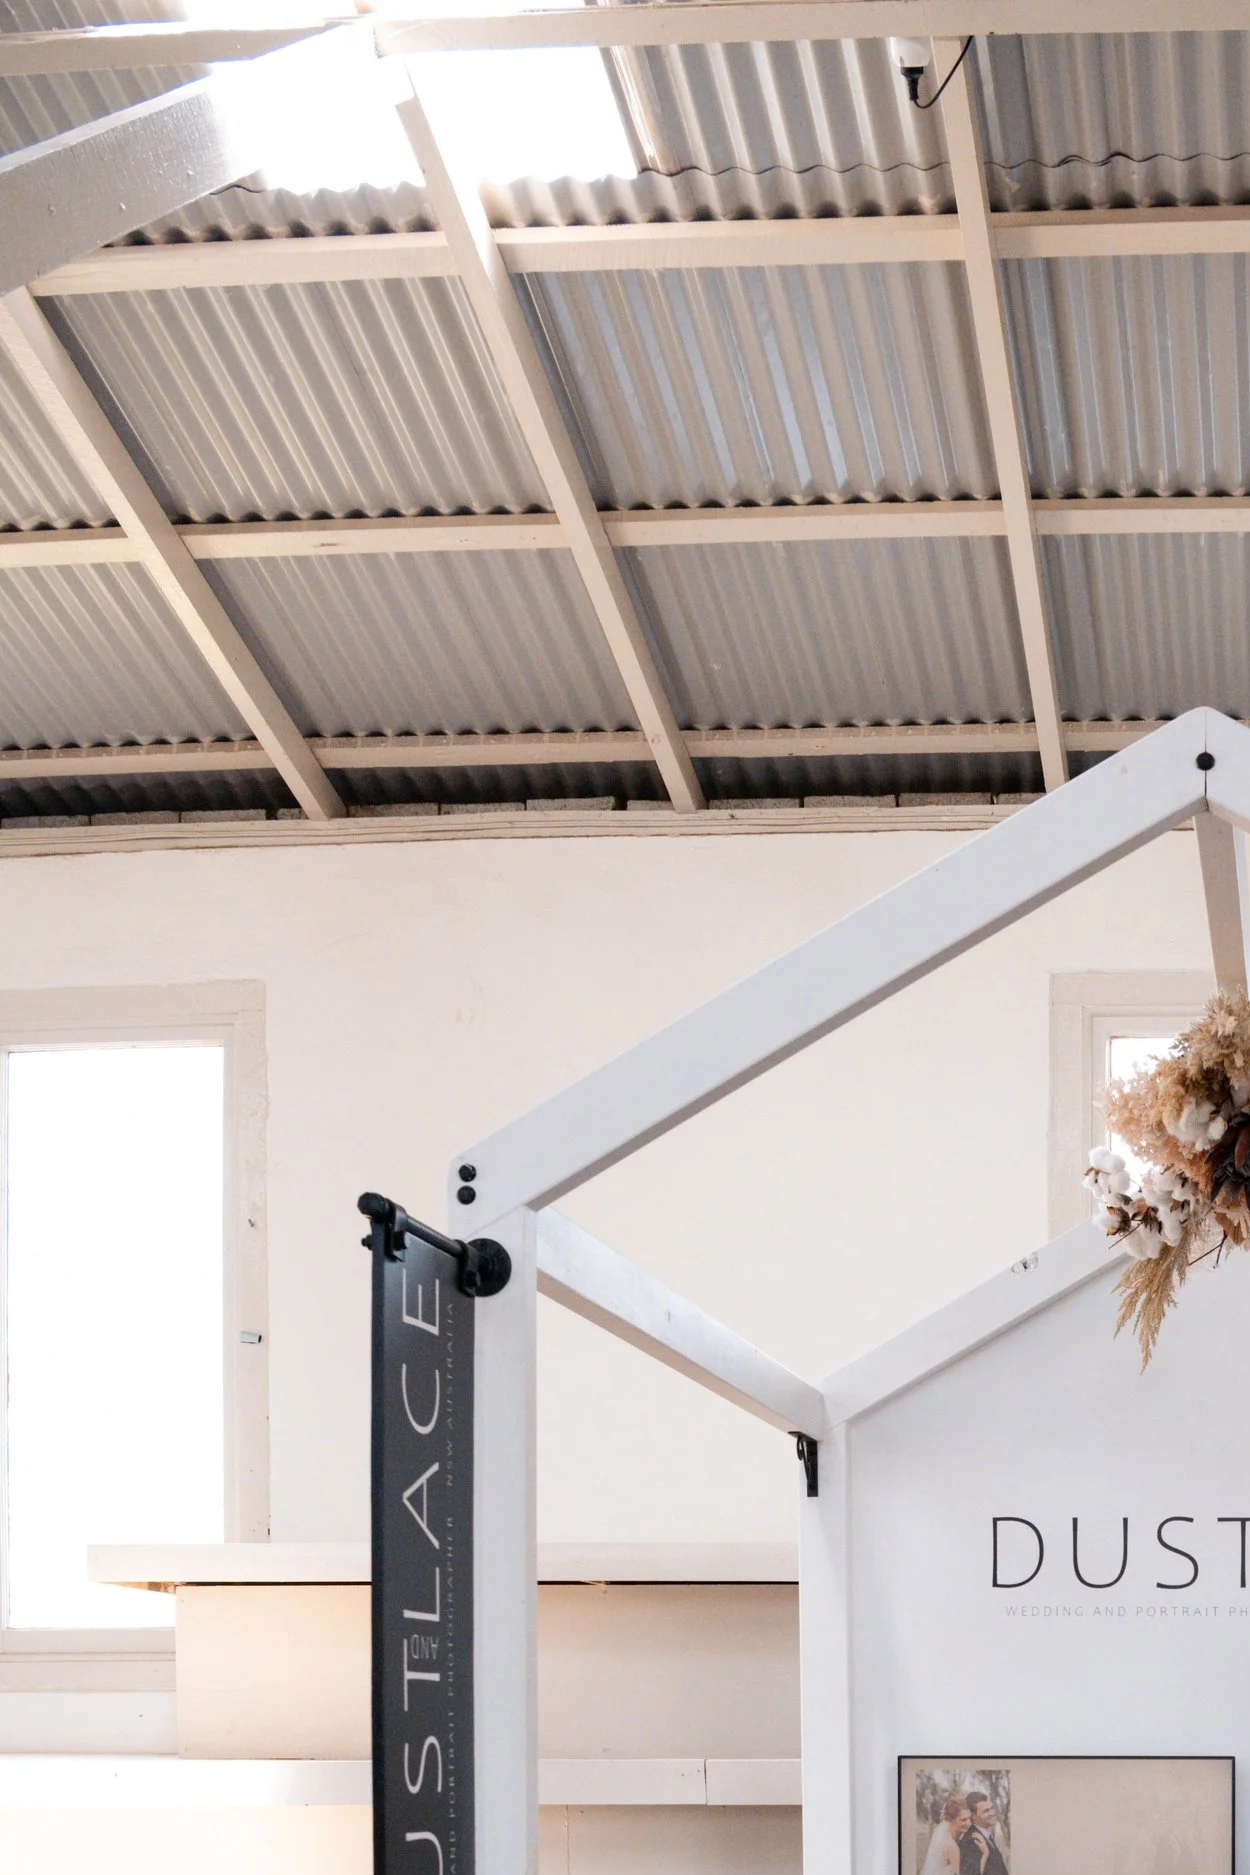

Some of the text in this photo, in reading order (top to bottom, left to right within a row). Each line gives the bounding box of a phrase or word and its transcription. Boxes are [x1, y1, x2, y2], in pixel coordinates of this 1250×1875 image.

[446, 1440, 454, 1487] NSW
[1005, 1606, 1084, 1618] WEDDING
[1092, 1606, 1126, 1618] AND
[1136, 1606, 1220, 1618] PORTRAIT
[449, 1830, 457, 1874] AND
